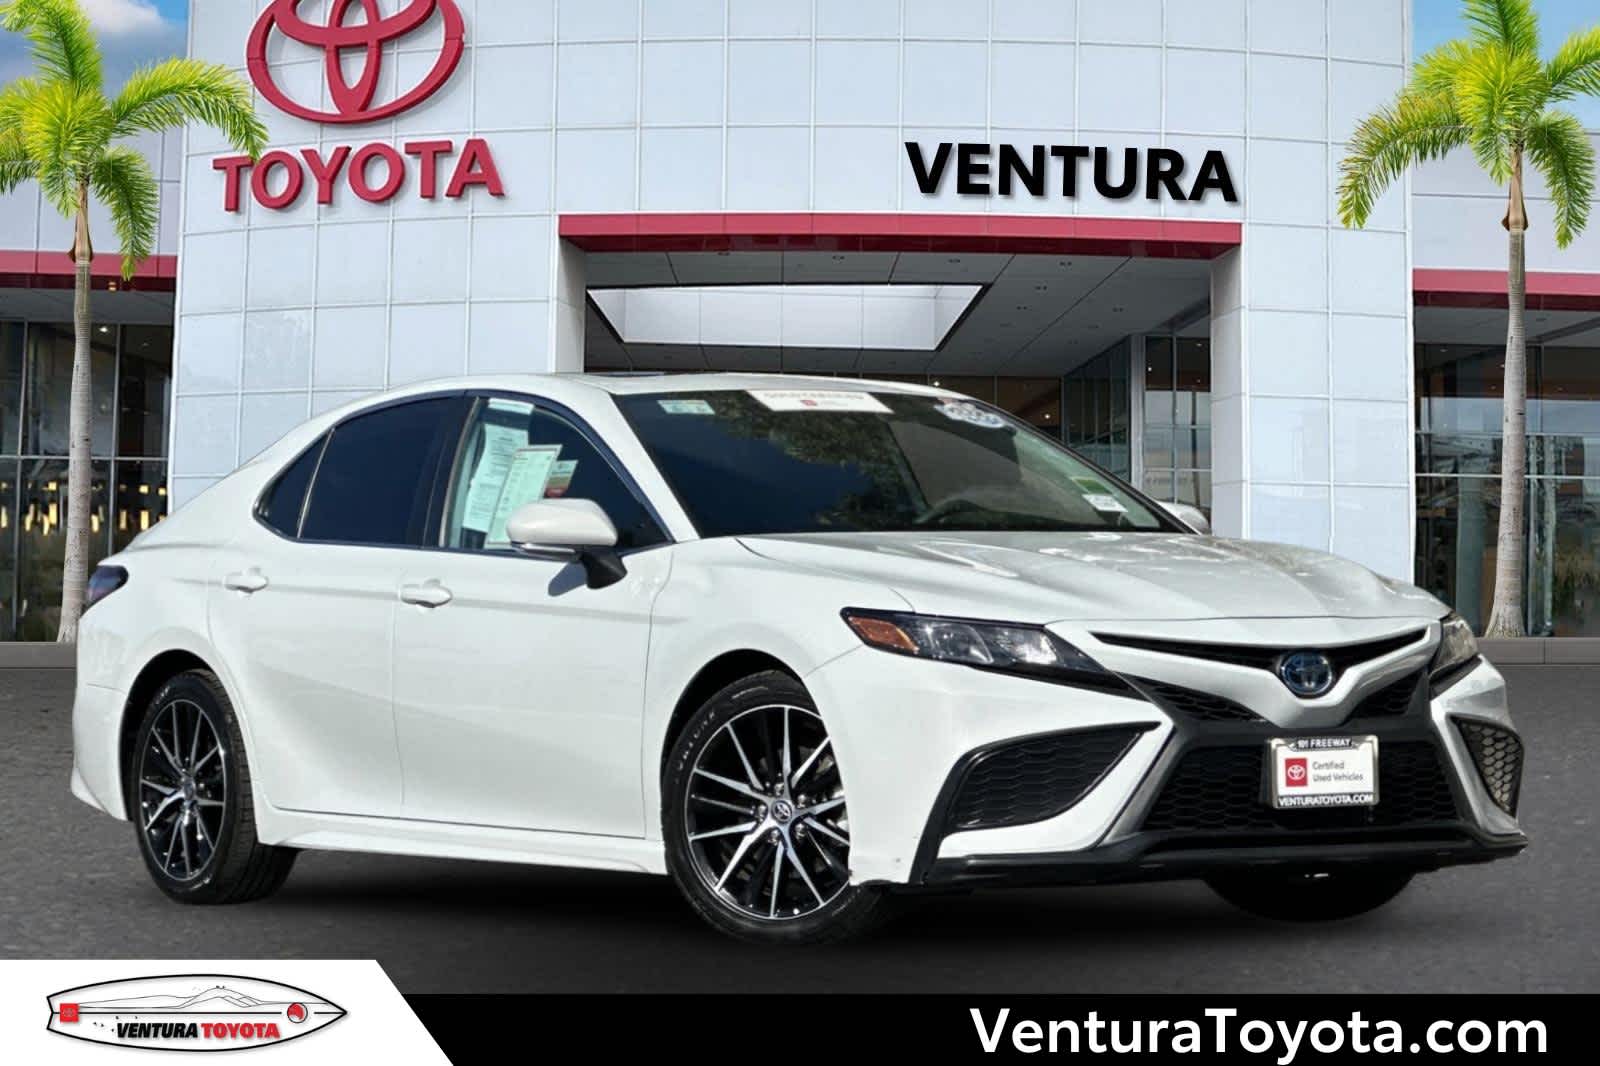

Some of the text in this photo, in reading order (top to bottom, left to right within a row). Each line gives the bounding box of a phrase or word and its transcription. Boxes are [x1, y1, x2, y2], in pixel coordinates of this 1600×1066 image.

[212, 138, 505, 212] TOYOTA
[905, 141, 1239, 203] VENTURA
[1310, 738, 1350, 748] FREEWAY
[1312, 761, 1345, 770] Certified
[1312, 773, 1364, 782] Used Vehicles
[1279, 795, 1374, 807] VENTURATOYOTA.COM
